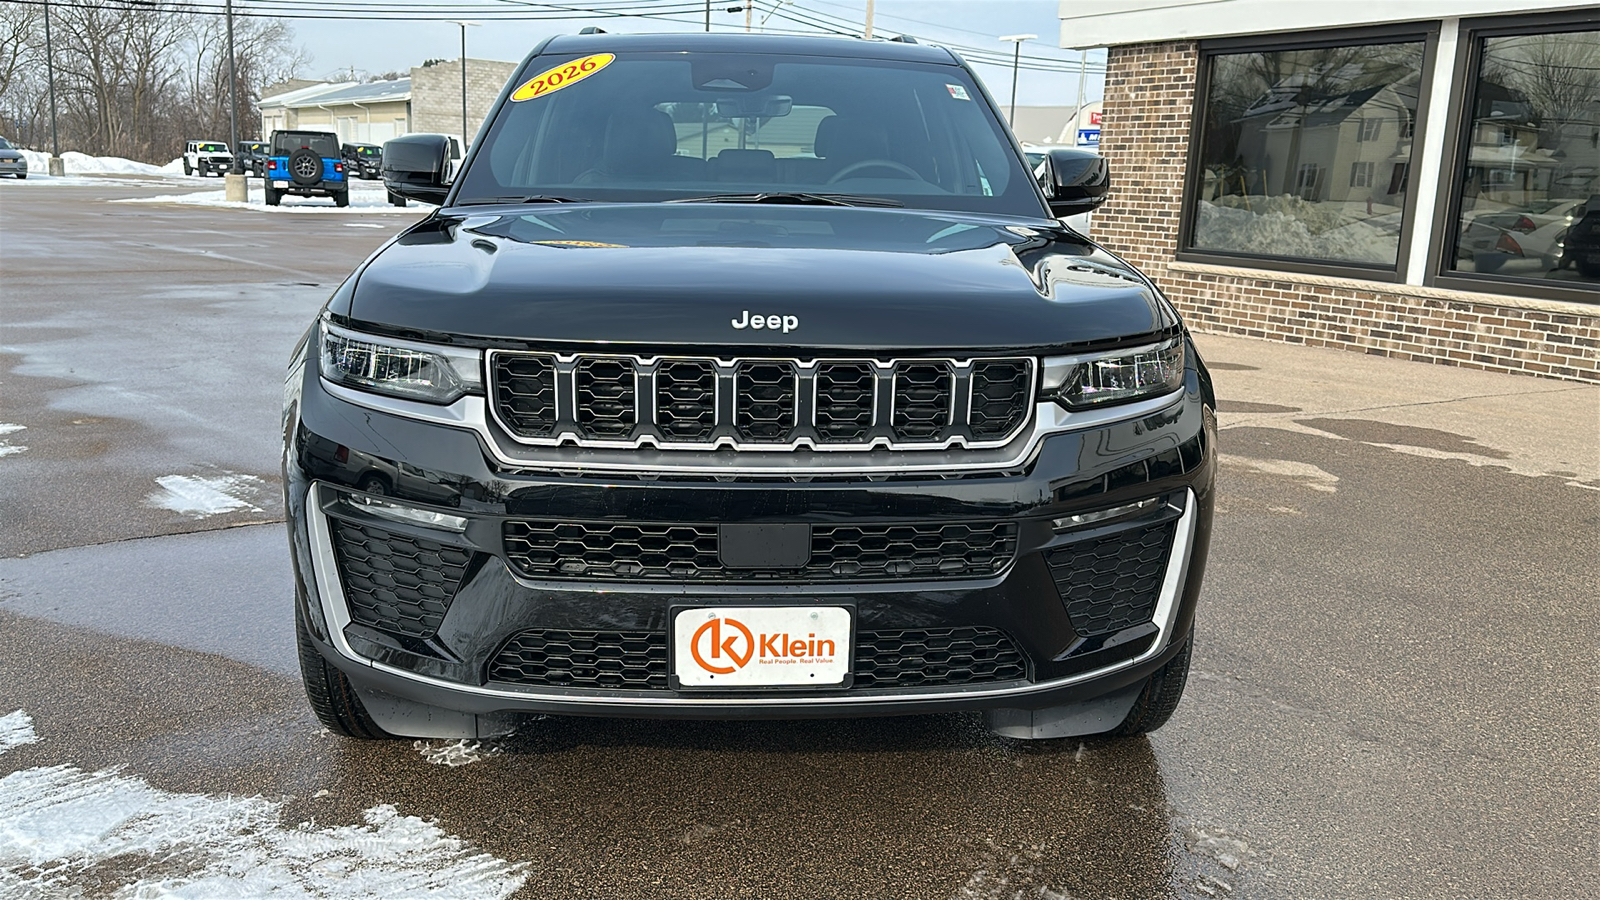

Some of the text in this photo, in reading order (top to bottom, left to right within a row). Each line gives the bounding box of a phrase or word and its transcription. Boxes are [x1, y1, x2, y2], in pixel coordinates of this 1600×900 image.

[530, 57, 596, 95] 2026
[731, 310, 799, 334] Jeep
[759, 633, 835, 657] Klein
